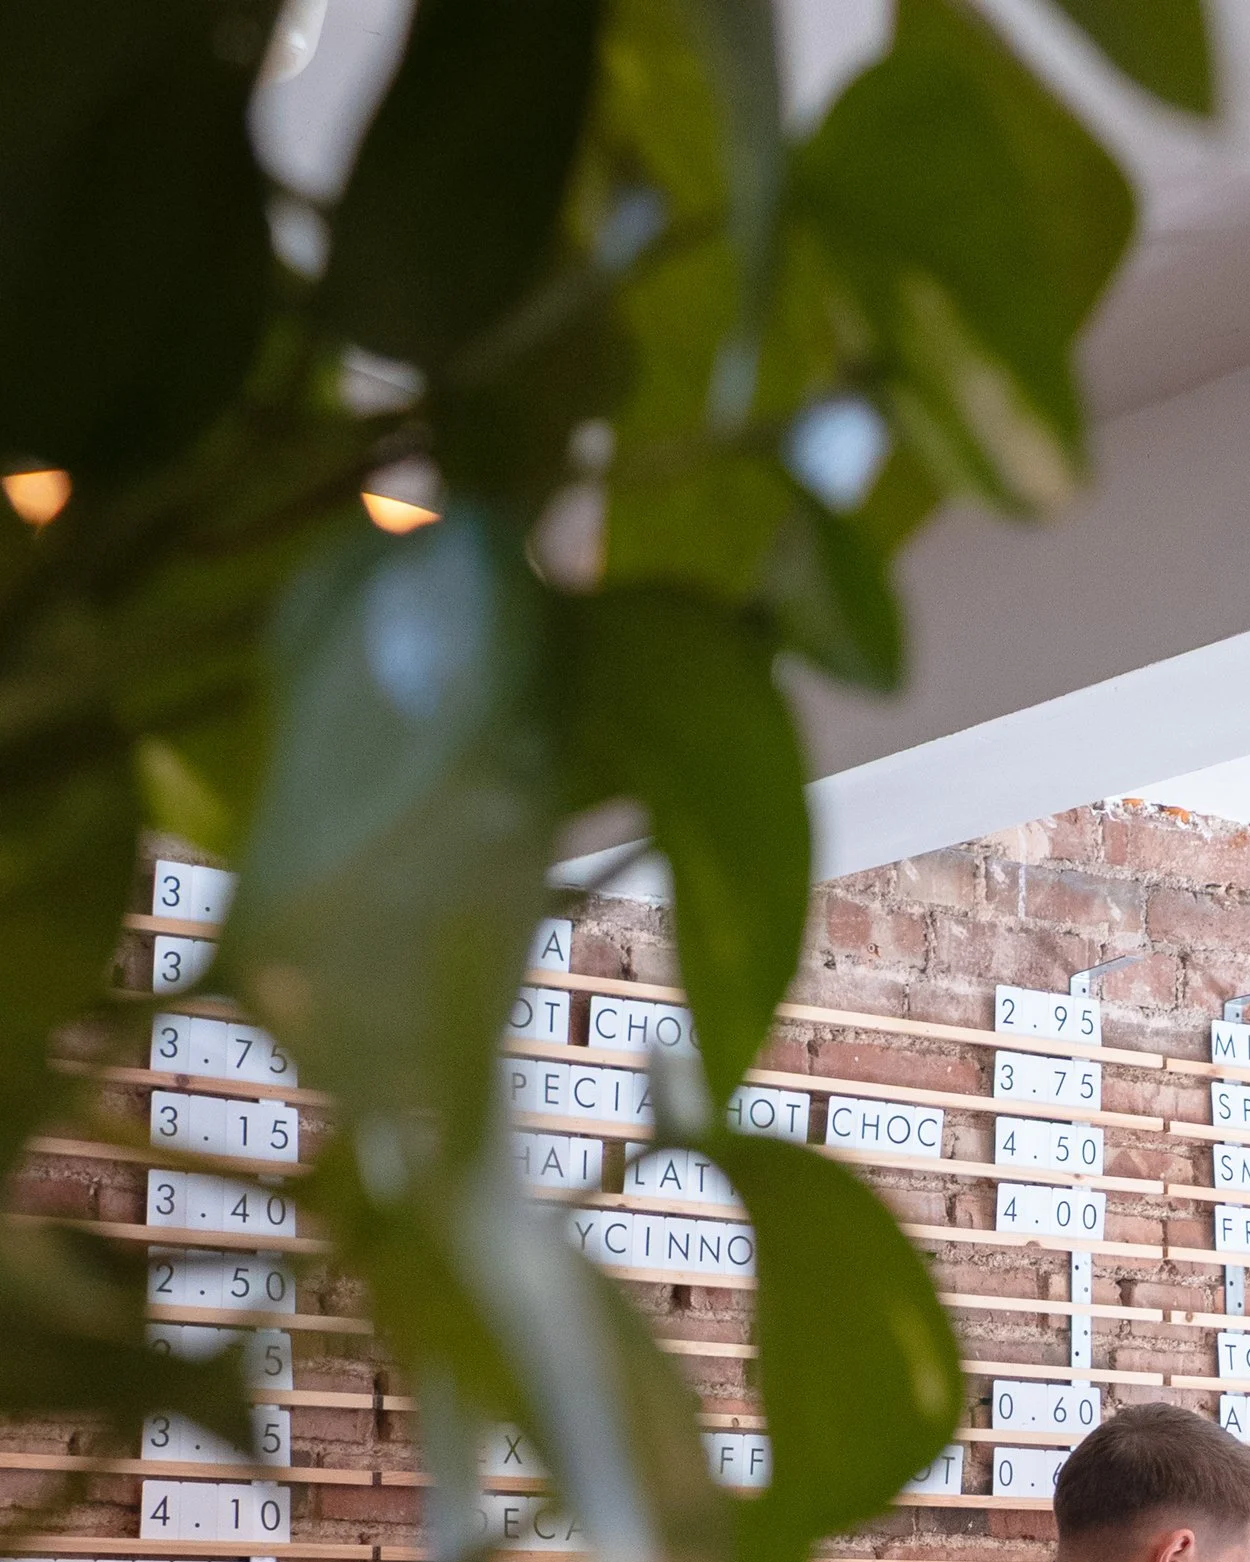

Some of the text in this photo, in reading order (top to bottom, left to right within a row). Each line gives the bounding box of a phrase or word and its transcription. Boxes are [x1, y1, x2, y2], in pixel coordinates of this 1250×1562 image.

[509, 997, 561, 1033] OT
[1002, 998, 1094, 1036] 2.95
[160, 1027, 288, 1074] 3.75
[1000, 1064, 1094, 1099] 3.75
[158, 1106, 289, 1150] 3.15
[832, 1107, 938, 1147] CHOC
[1002, 1130, 1096, 1165] 4.50
[155, 1183, 286, 1227] 3.40
[1003, 1196, 1097, 1230] 4.00
[575, 1220, 754, 1266] YCINNO
[155, 1263, 286, 1302] 2.50
[998, 1392, 1094, 1426] 0.60
[149, 1495, 282, 1532] 4.10
